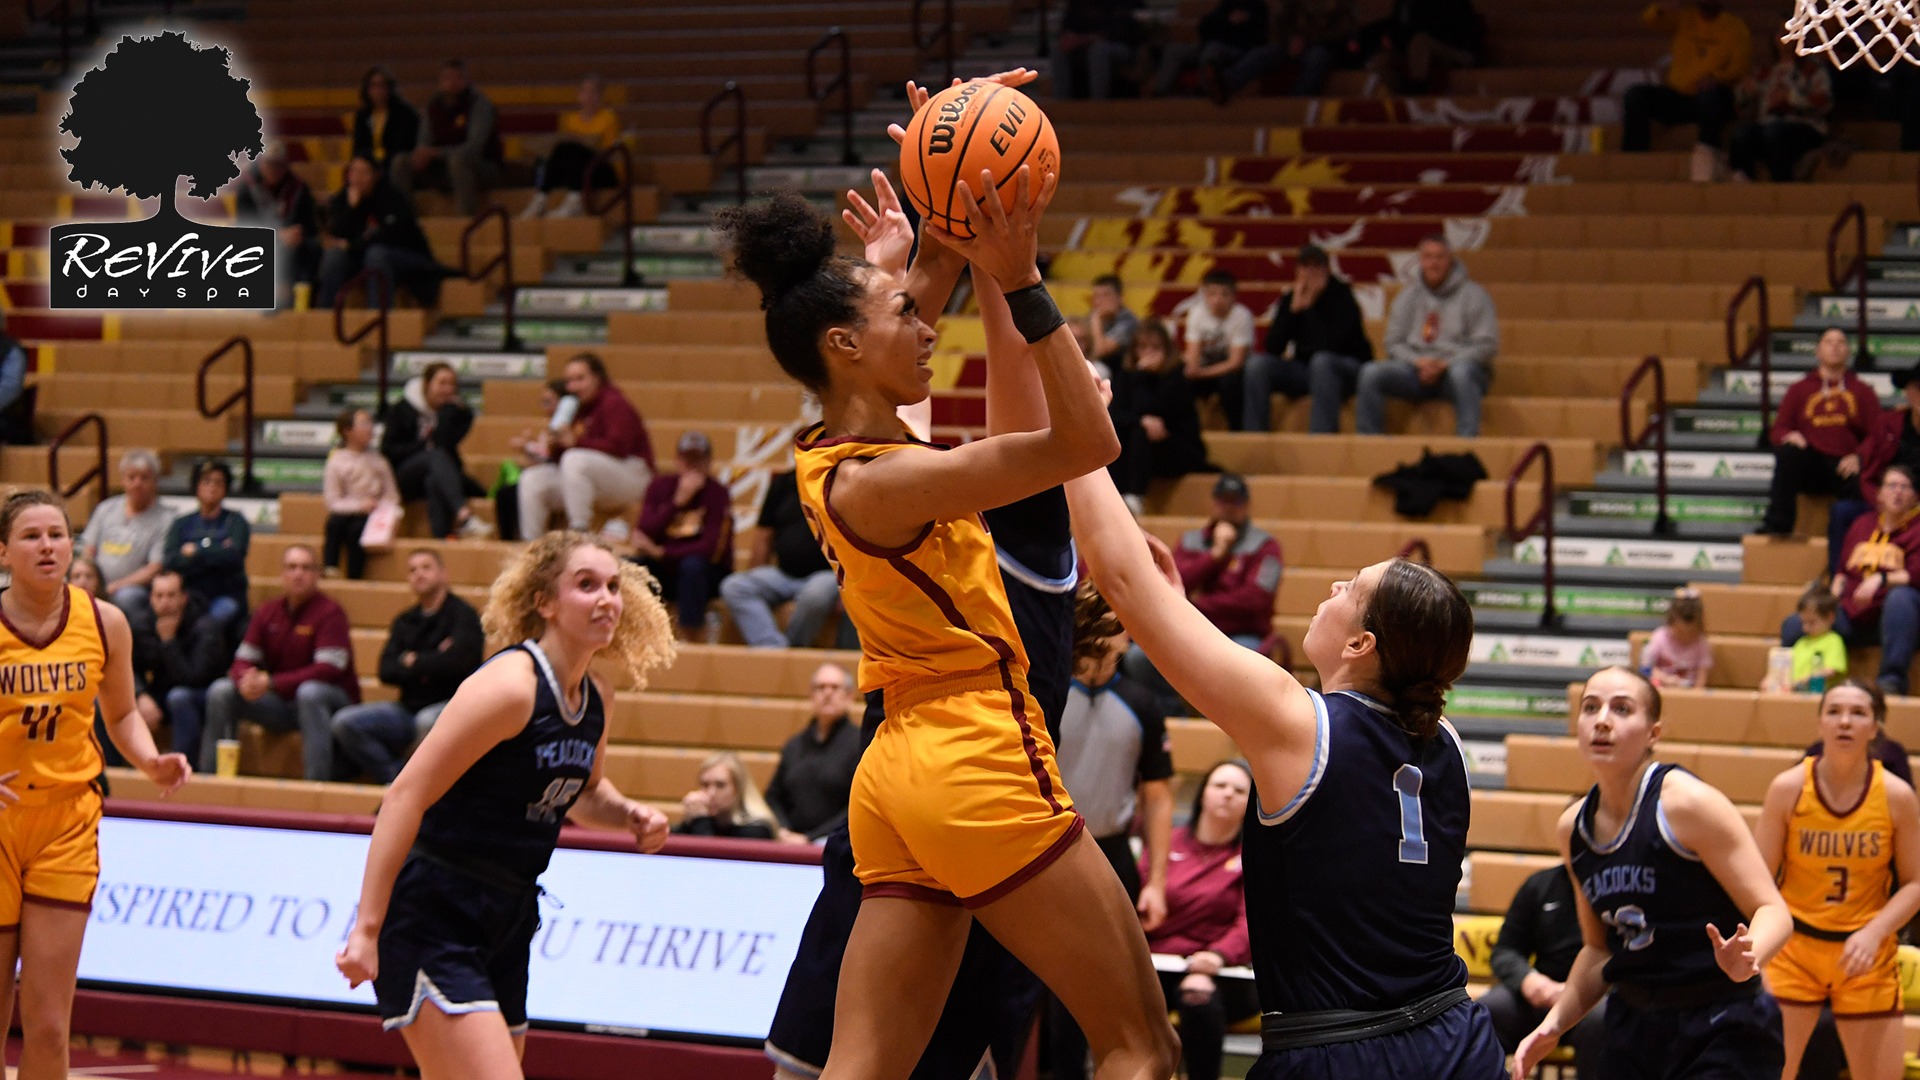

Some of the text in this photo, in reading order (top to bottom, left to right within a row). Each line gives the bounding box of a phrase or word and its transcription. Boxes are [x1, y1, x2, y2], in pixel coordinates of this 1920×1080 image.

[928, 82, 984, 157] Wilson
[0, 662, 86, 695] WOLVES
[21, 704, 62, 742] 41
[1393, 763, 1428, 865] 1
[1800, 829, 1881, 858] WOLVES
[1582, 865, 1656, 904] EACOCKS
[1825, 866, 1848, 903] 3
[266, 893, 331, 941] TO
[594, 918, 776, 976] THRIVE
